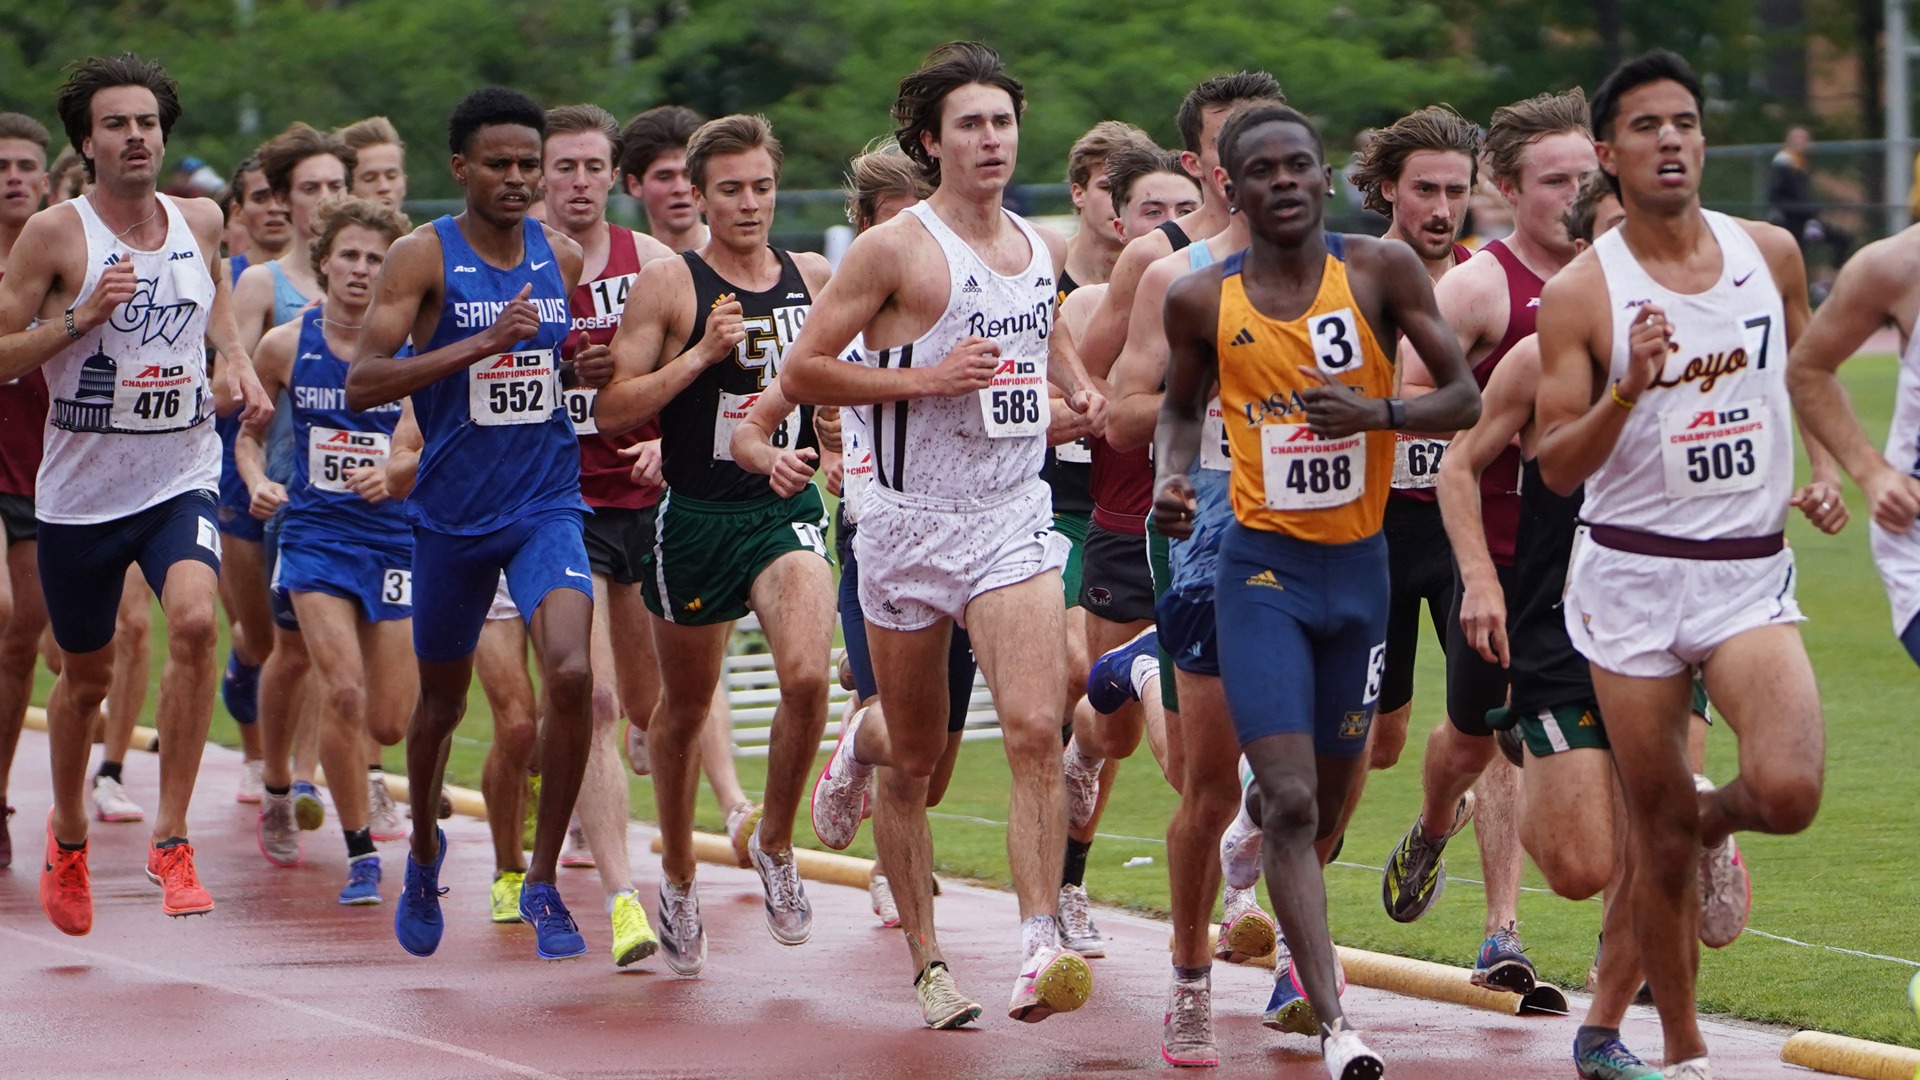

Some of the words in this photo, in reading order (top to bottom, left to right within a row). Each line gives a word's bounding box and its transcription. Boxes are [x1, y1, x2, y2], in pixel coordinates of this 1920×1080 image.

[168, 251, 194, 261] A10
[595, 276, 632, 315] 14
[109, 277, 197, 346] GW
[454, 301, 509, 329] SAIN
[1316, 316, 1354, 369] 3
[1744, 315, 1771, 370] 7
[135, 365, 184, 379] A10
[476, 368, 551, 381] CHAMPIONSHIPS
[490, 354, 541, 370] A10
[995, 359, 1036, 375] A10
[121, 376, 192, 388] CHAMPIONSHIPS
[989, 376, 1043, 387] AMPIONSHIPS
[133, 389, 180, 420] 476
[294, 386, 346, 411] SAINT
[489, 380, 544, 415] 552
[992, 389, 1040, 425] 583
[1687, 408, 1749, 430] A10
[327, 430, 376, 446] A10
[1670, 421, 1763, 445] CHAMPIONSHIPS
[316, 442, 385, 457] CHAMPIONSHIPS
[1270, 438, 1360, 455] CHAMPIONSHIPS
[1408, 441, 1450, 476] 62
[1687, 438, 1756, 484] 503
[1285, 455, 1352, 494] 488
[386, 571, 412, 602] 3
